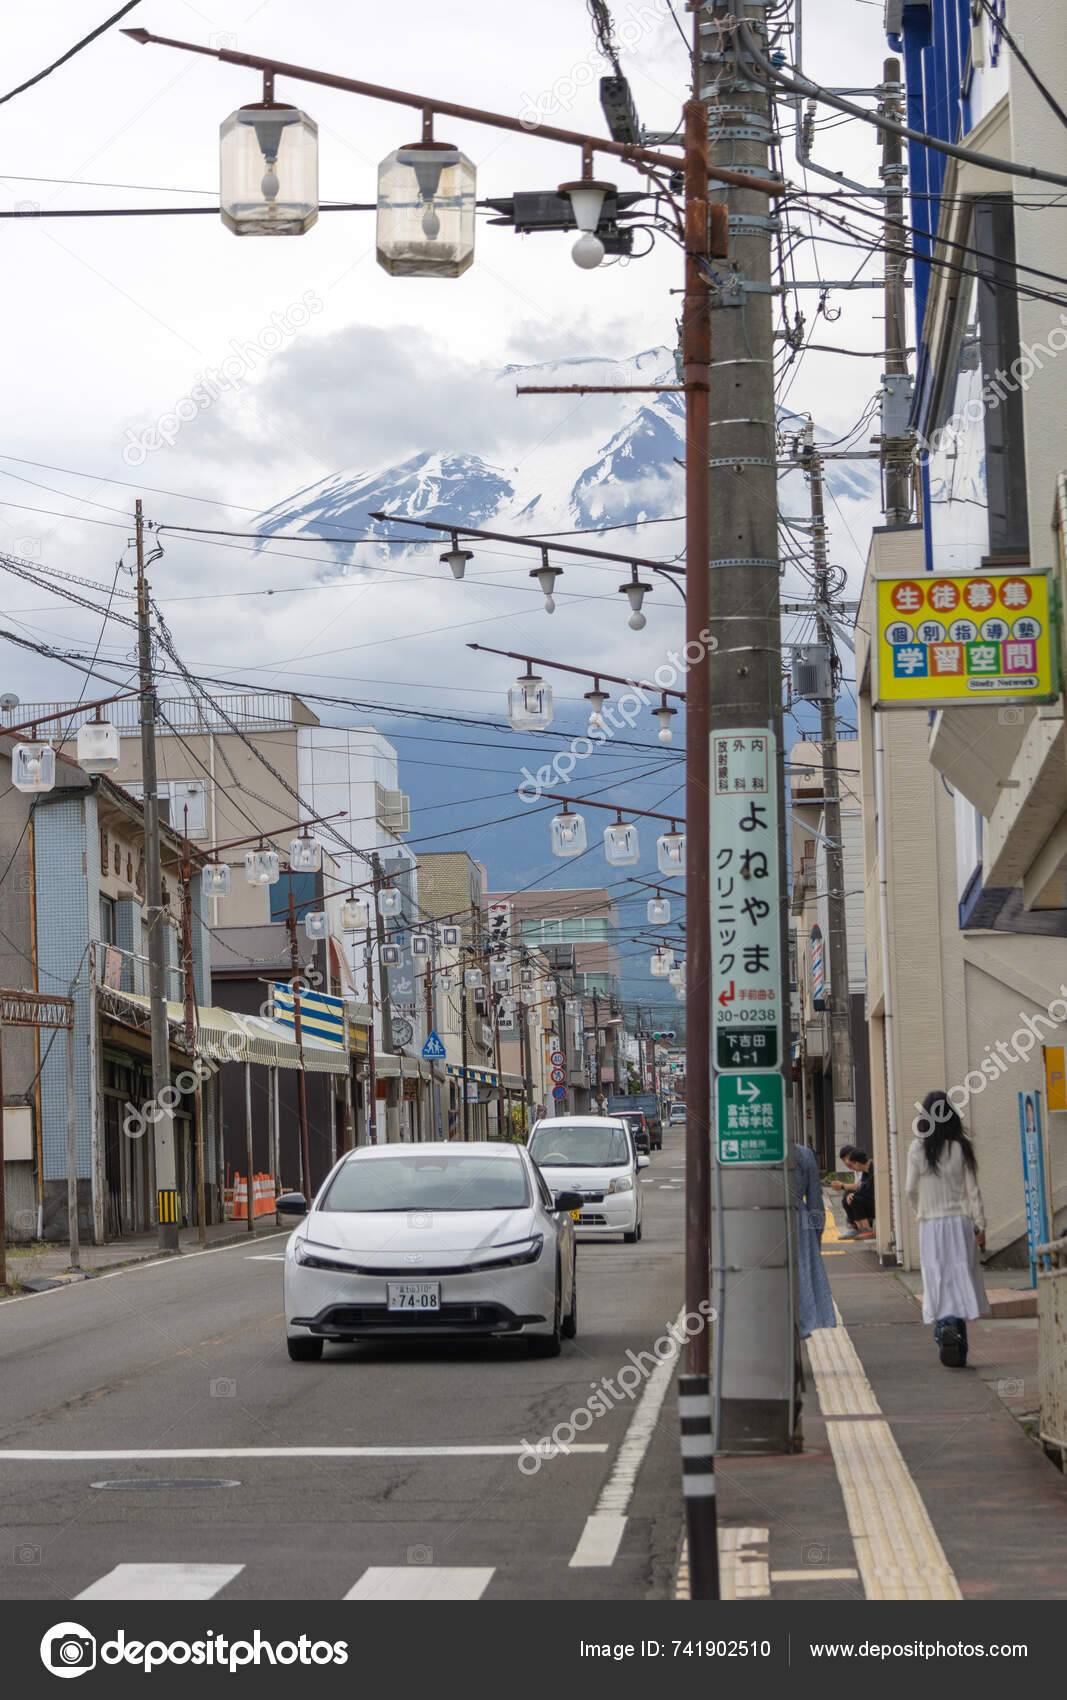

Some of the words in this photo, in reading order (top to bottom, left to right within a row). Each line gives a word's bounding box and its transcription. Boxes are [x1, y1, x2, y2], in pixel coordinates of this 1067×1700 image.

[896, 582, 1028, 610] 生徒募集
[892, 622, 1034, 643] 個別指導塾
[897, 643, 1033, 674] 学習空間
[733, 740, 746, 790] 外科
[751, 739, 764, 790] 内科
[739, 801, 769, 974] よねやま
[717, 848, 736, 975] クリニック
[738, 988, 776, 1001] 手前曲る
[717, 1009, 776, 1022] 30-0238
[726, 1034, 766, 1048] 下吉田
[731, 1050, 758, 1064] 4-1
[727, 1116, 774, 1129] 高等学校
[399, 1294, 437, 1308] 74-08
